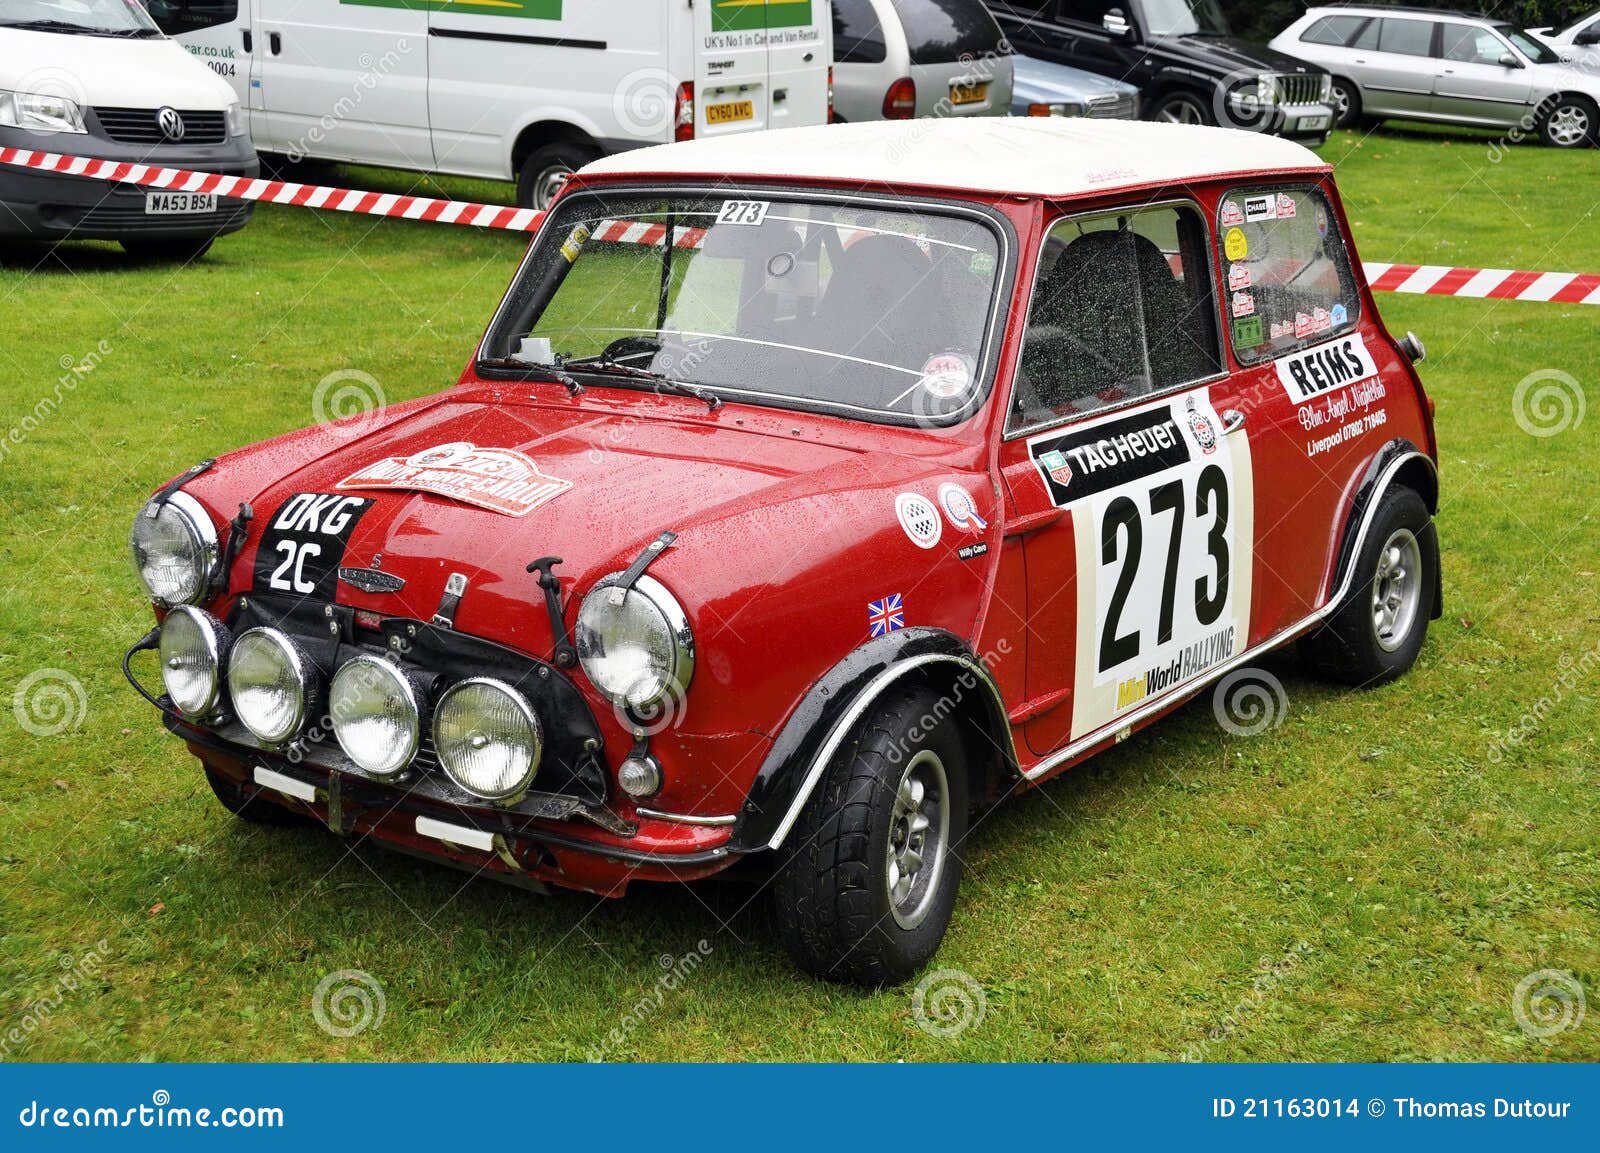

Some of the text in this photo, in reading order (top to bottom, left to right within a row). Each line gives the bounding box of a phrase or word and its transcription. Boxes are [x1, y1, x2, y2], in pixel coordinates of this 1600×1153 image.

[704, 36, 724, 49] UK's
[726, 35, 743, 47] No.1
[745, 34, 753, 46] in
[754, 33, 768, 45] Car
[769, 32, 783, 44] and
[784, 31, 798, 42] Van
[709, 102, 751, 121] CY60 AVC
[152, 193, 212, 211] WA53 BSA
[721, 201, 763, 223] 273
[1288, 340, 1364, 397] REIMS
[1297, 403, 1324, 431] Blue
[1323, 389, 1351, 424] Angel
[1307, 428, 1343, 457] Liverpool
[449, 455, 514, 473] 273
[273, 493, 365, 535] DKG
[269, 539, 322, 594] 2C
[1098, 463, 1230, 674] 273
[1182, 625, 1235, 679] RALLYING
